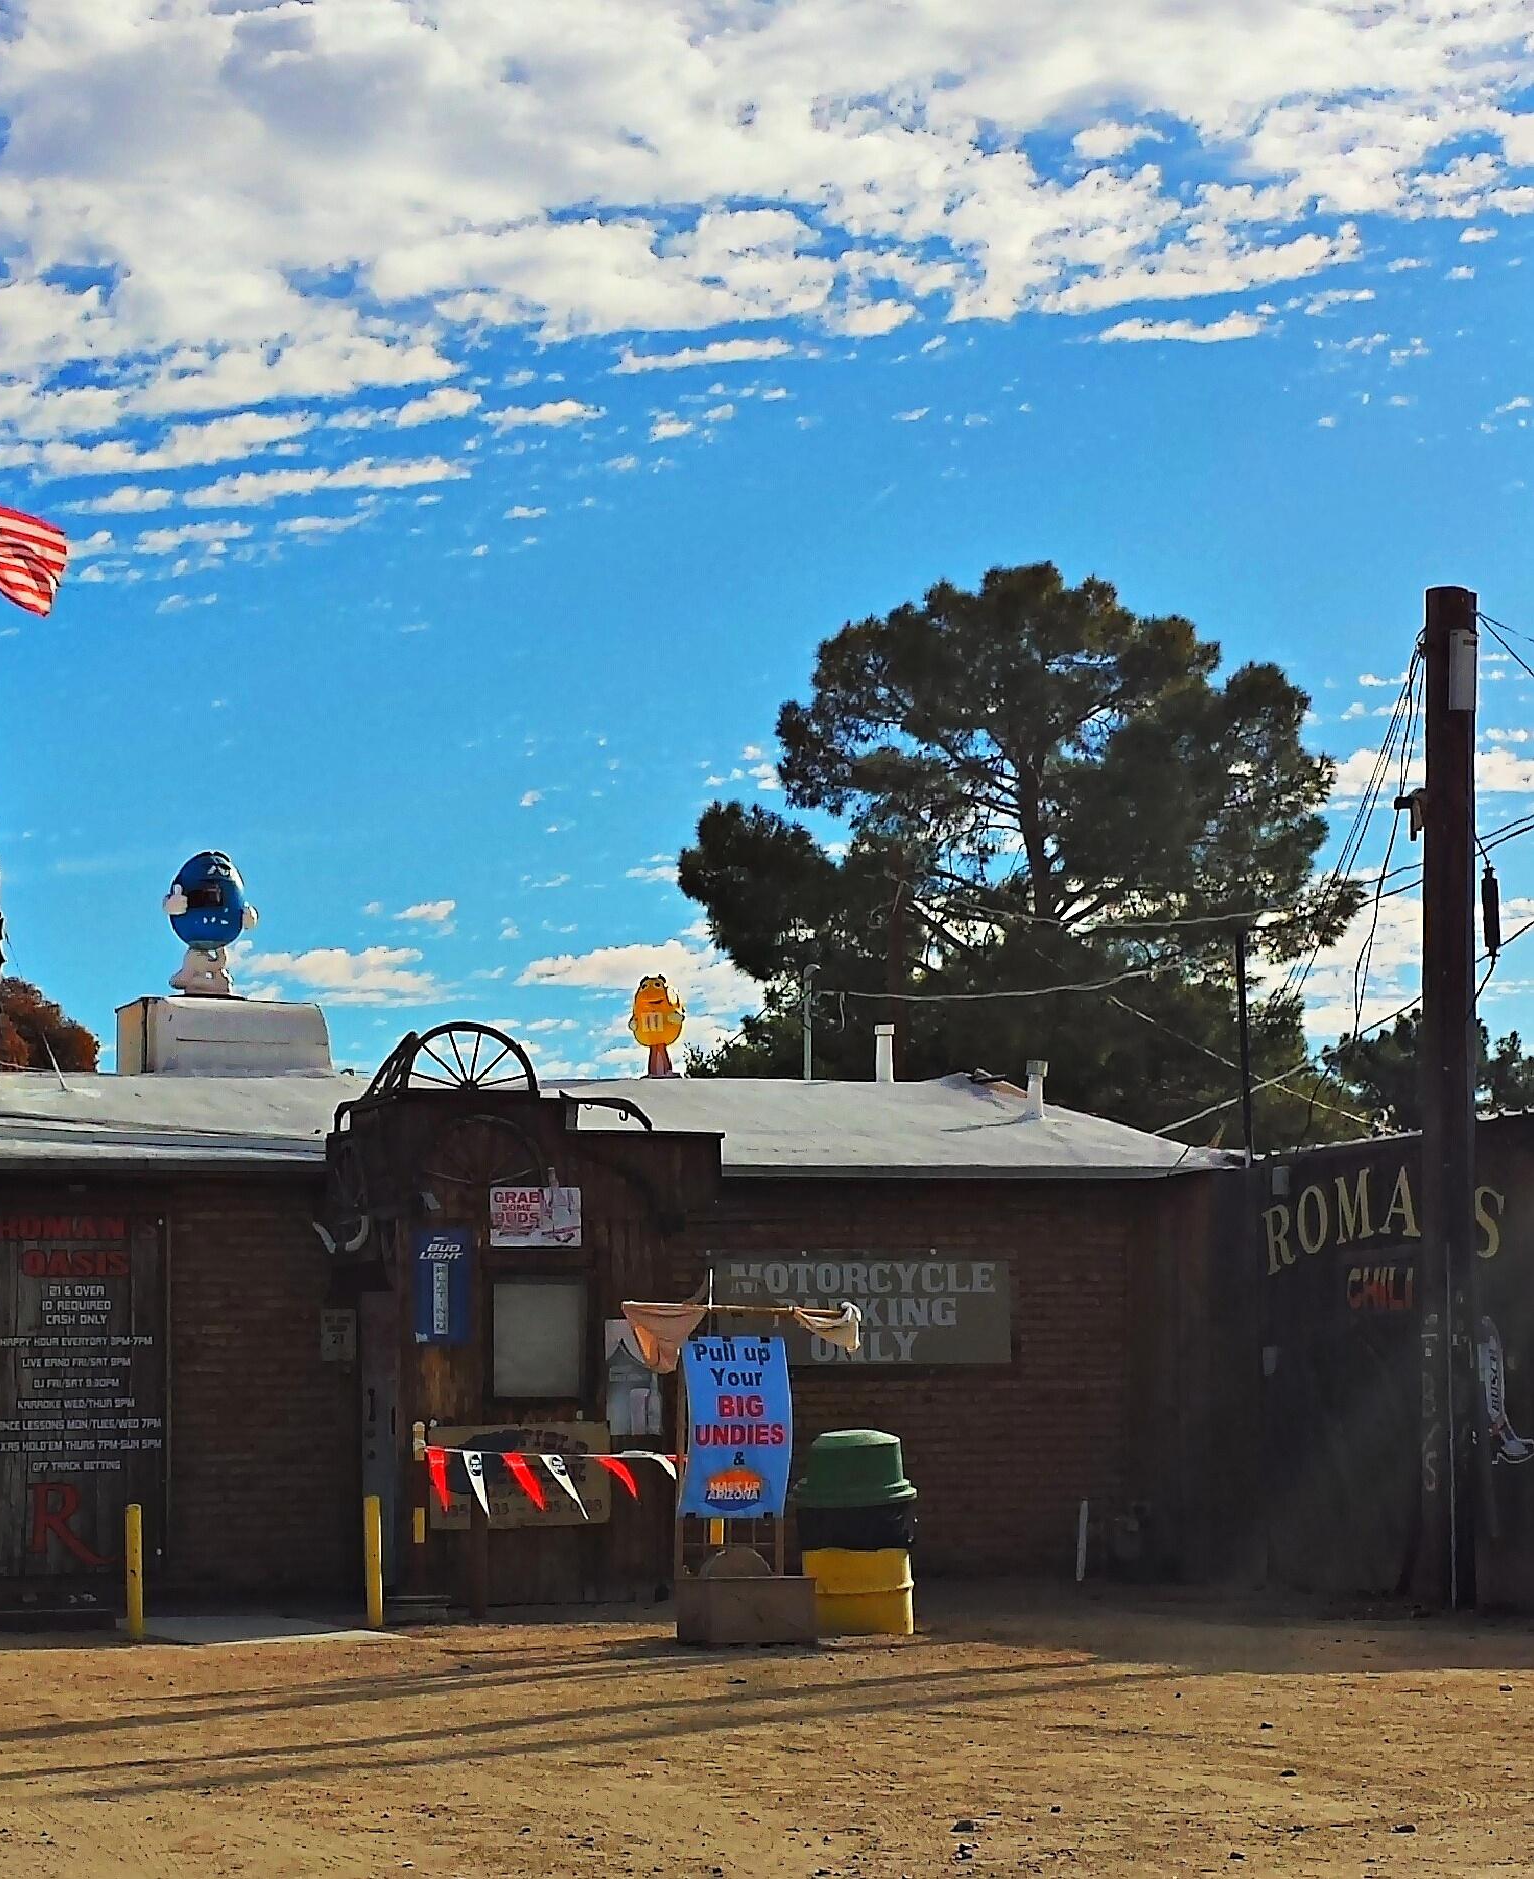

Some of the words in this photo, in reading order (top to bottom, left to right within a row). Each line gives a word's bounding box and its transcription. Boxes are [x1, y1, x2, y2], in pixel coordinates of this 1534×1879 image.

[494, 1191, 541, 1204] GRAB
[1260, 1165, 1506, 1276] ROMAS
[427, 1243, 462, 1253] BUD
[419, 1252, 464, 1260] LIGHT
[22, 1249, 131, 1278] OASIS
[729, 1262, 996, 1294] MOTORCYCLE
[75, 1285, 105, 1297] OVER
[57, 1300, 112, 1312] REQUIRED
[46, 1314, 75, 1325] CASH
[80, 1314, 107, 1325] ONLY
[0, 1337, 32, 1347] HAPPY
[34, 1337, 60, 1347] HOUR
[62, 1336, 108, 1347] EVERYDAY
[694, 1343, 736, 1363] Pull
[744, 1346, 770, 1366] up
[22, 1357, 42, 1368] LIVE
[44, 1357, 70, 1367] BAND
[33, 1378, 45, 1388] DJ
[710, 1368, 763, 1387] Your
[18, 1400, 62, 1409] KARAOKE
[717, 1395, 764, 1418] BIG
[23, 1420, 65, 1431] LESSONS
[695, 1423, 784, 1446] UNDIES
[733, 1452, 746, 1466] &
[32, 1461, 49, 1473] OFF
[51, 1461, 82, 1472] TRACK
[83, 1460, 121, 1471] BETTING
[706, 1489, 761, 1500] ARIZONA
[29, 1482, 119, 1567] R
